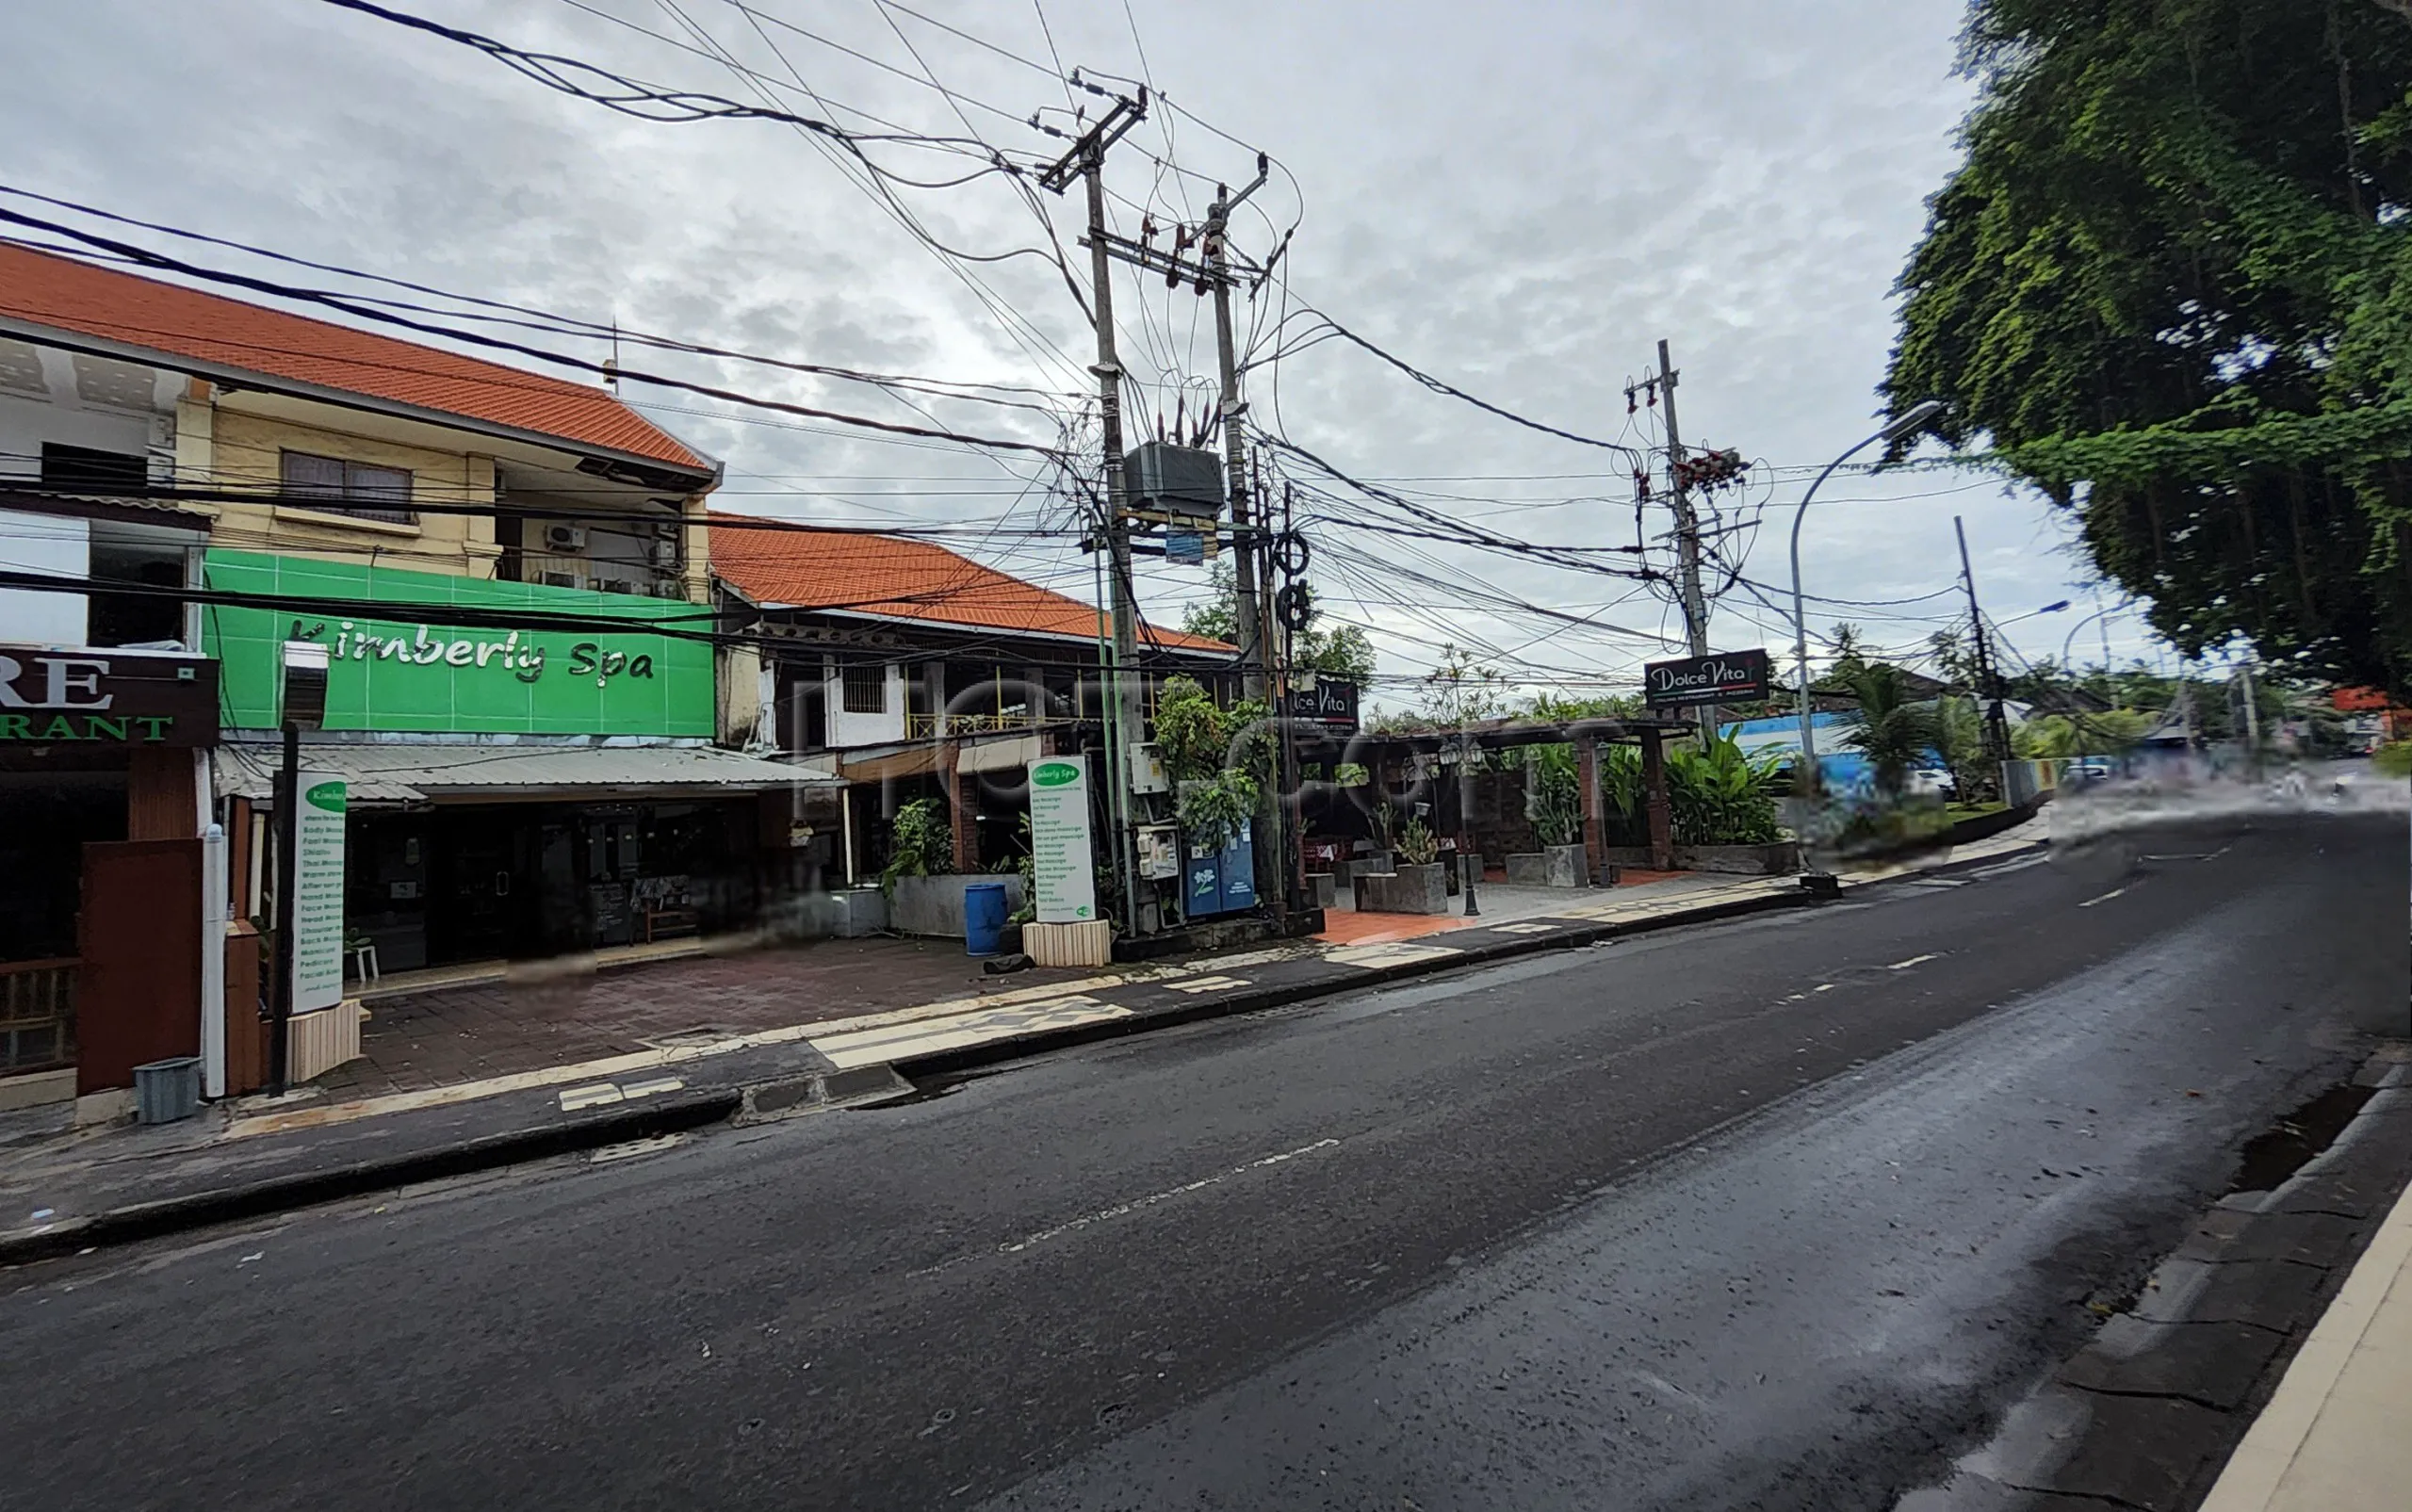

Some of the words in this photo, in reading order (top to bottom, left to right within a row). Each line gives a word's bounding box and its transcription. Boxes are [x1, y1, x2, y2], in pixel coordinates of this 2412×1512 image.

[290, 620, 546, 683] Kimberly
[567, 642, 654, 687] Spa
[0, 656, 113, 710] RE
[1651, 667, 1707, 691] Dolce
[1701, 660, 1745, 685] Vita
[1315, 684, 1345, 714] Vita
[0, 714, 172, 741] RANT
[1061, 768, 1075, 779] Spa
